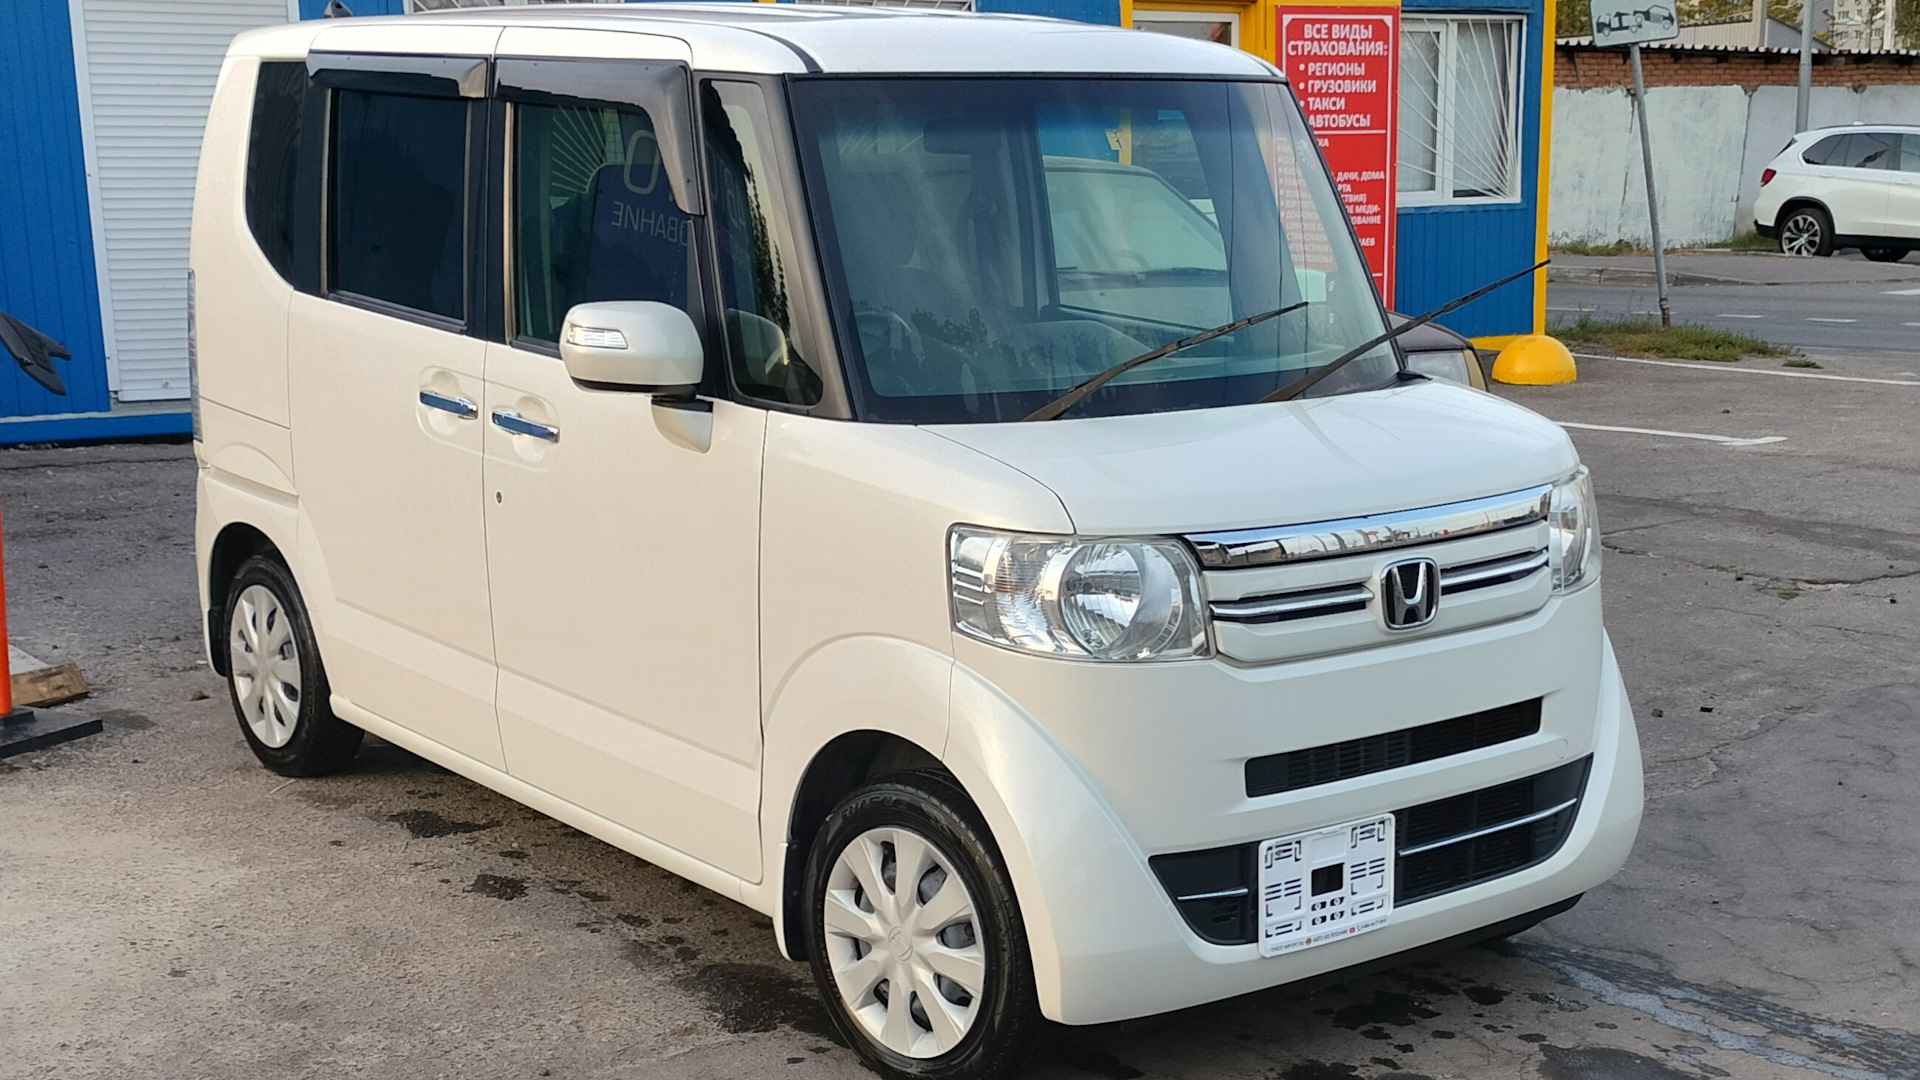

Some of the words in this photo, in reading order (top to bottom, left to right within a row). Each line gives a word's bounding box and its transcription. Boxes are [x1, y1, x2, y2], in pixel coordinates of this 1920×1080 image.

[1304, 24, 1328, 39] ВСЕ
[1331, 24, 1372, 41] ВИДЫ
[1287, 41, 1388, 56] СТРАХОВАНИЯ:
[1308, 62, 1365, 76] РЕГИОНЫ
[1308, 79, 1376, 93] ГРУЗОВИКИ
[1307, 97, 1345, 110] ТАКСИ
[1308, 114, 1370, 127] АВТОБУСЫ
[1336, 171, 1360, 182] ДАЧИ,
[1360, 170, 1385, 182] ДОМА
[1355, 204, 1381, 215] МЕДИ-
[1350, 215, 1382, 226] ОВАНИЕ
